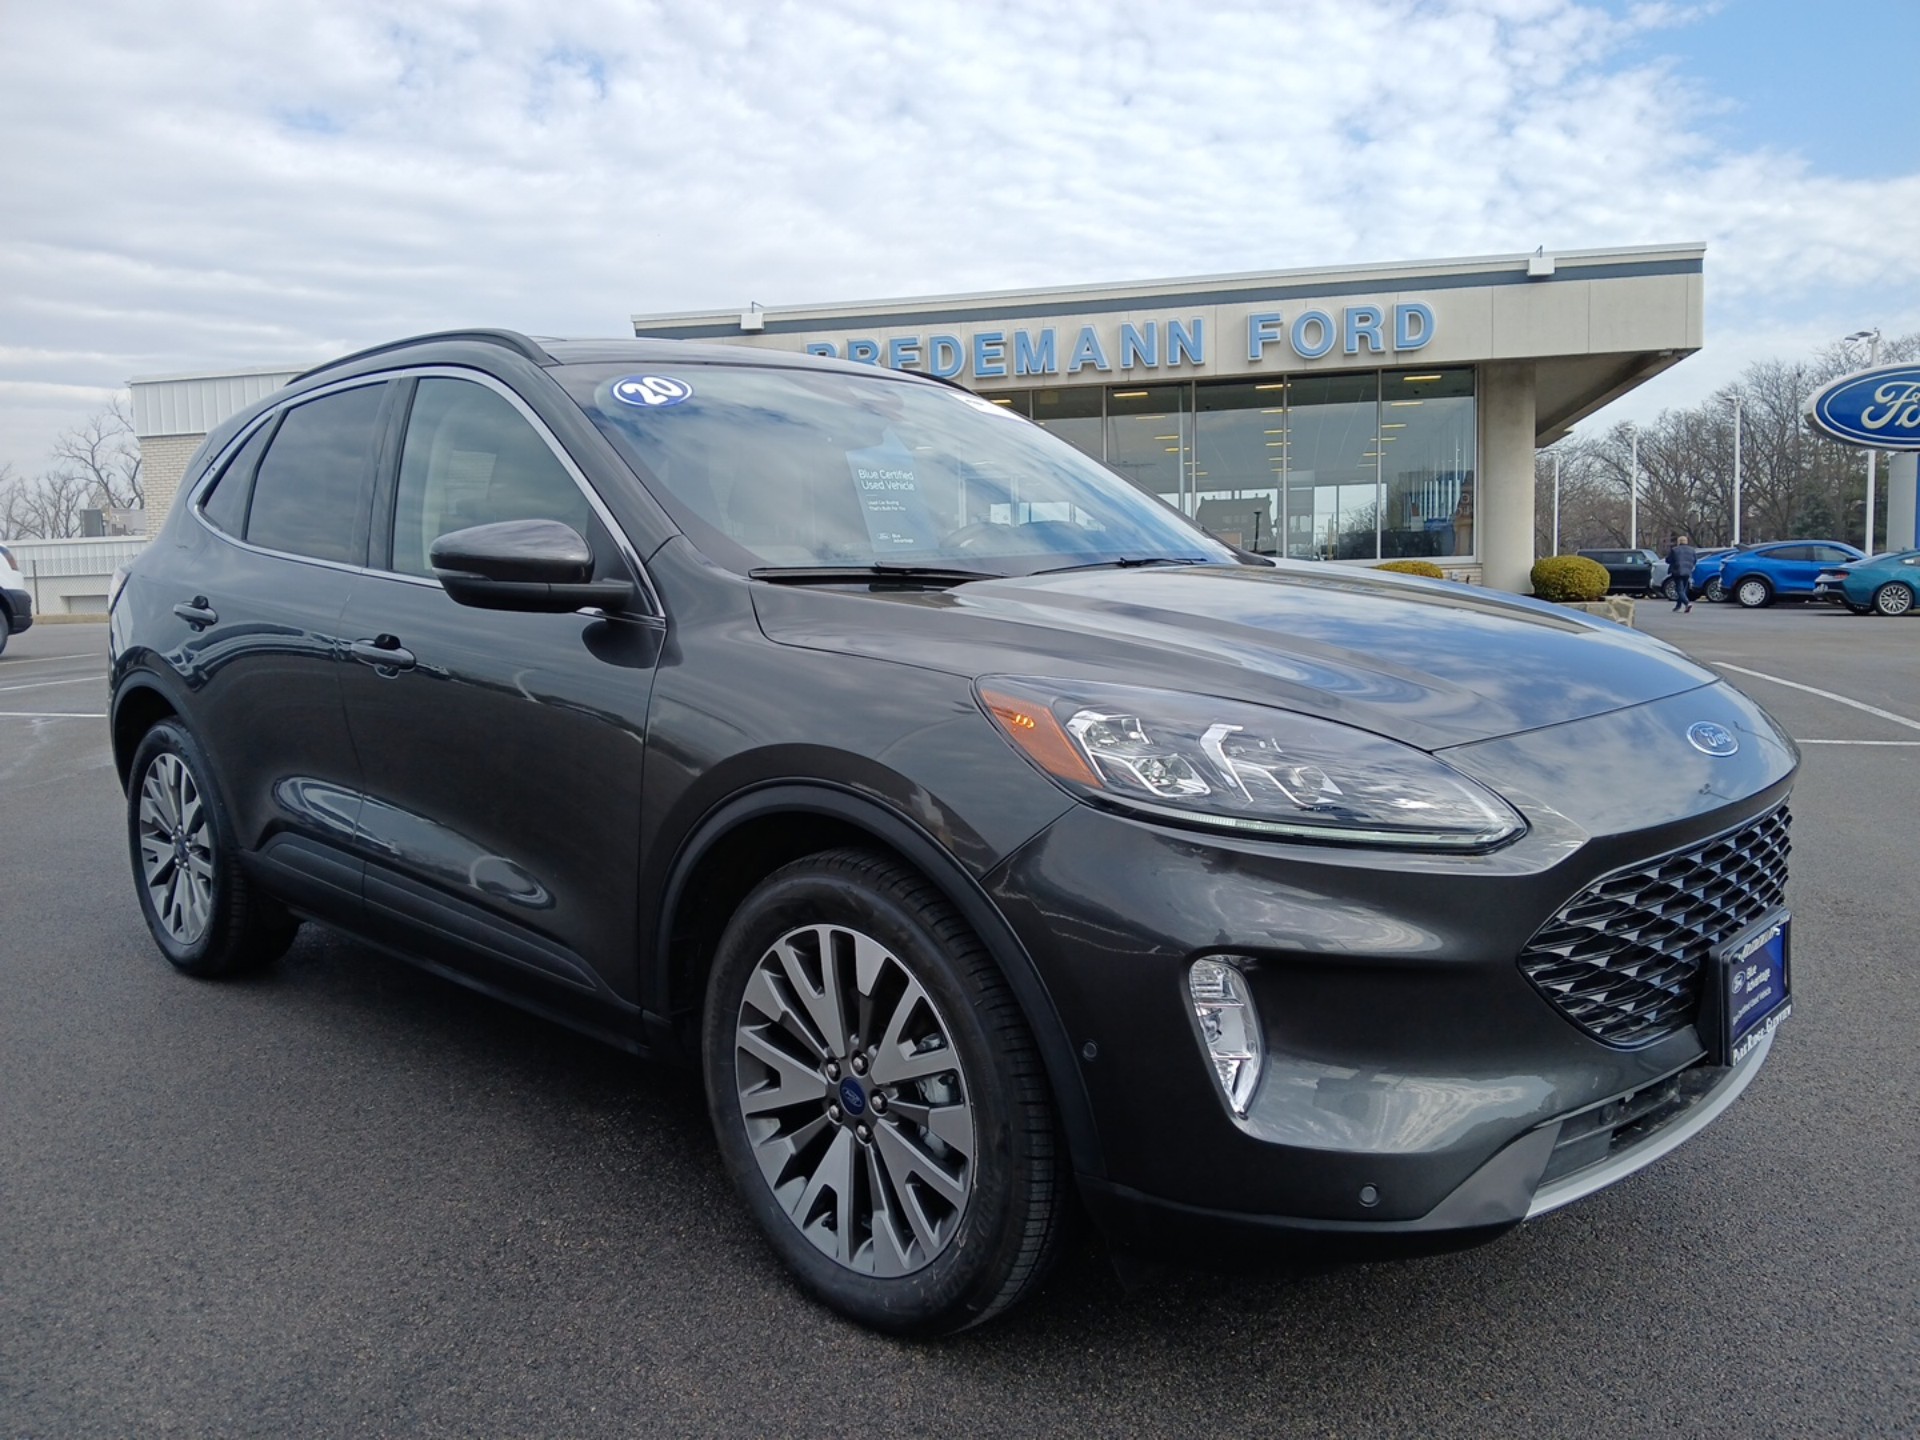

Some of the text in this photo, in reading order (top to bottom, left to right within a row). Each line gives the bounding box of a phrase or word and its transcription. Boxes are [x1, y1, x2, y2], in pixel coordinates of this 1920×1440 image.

[1246, 301, 1437, 362] FORD
[621, 376, 684, 405] 20
[1860, 381, 1920, 430] Fo
[862, 480, 885, 490] Used
[1699, 726, 1732, 748] Ford
